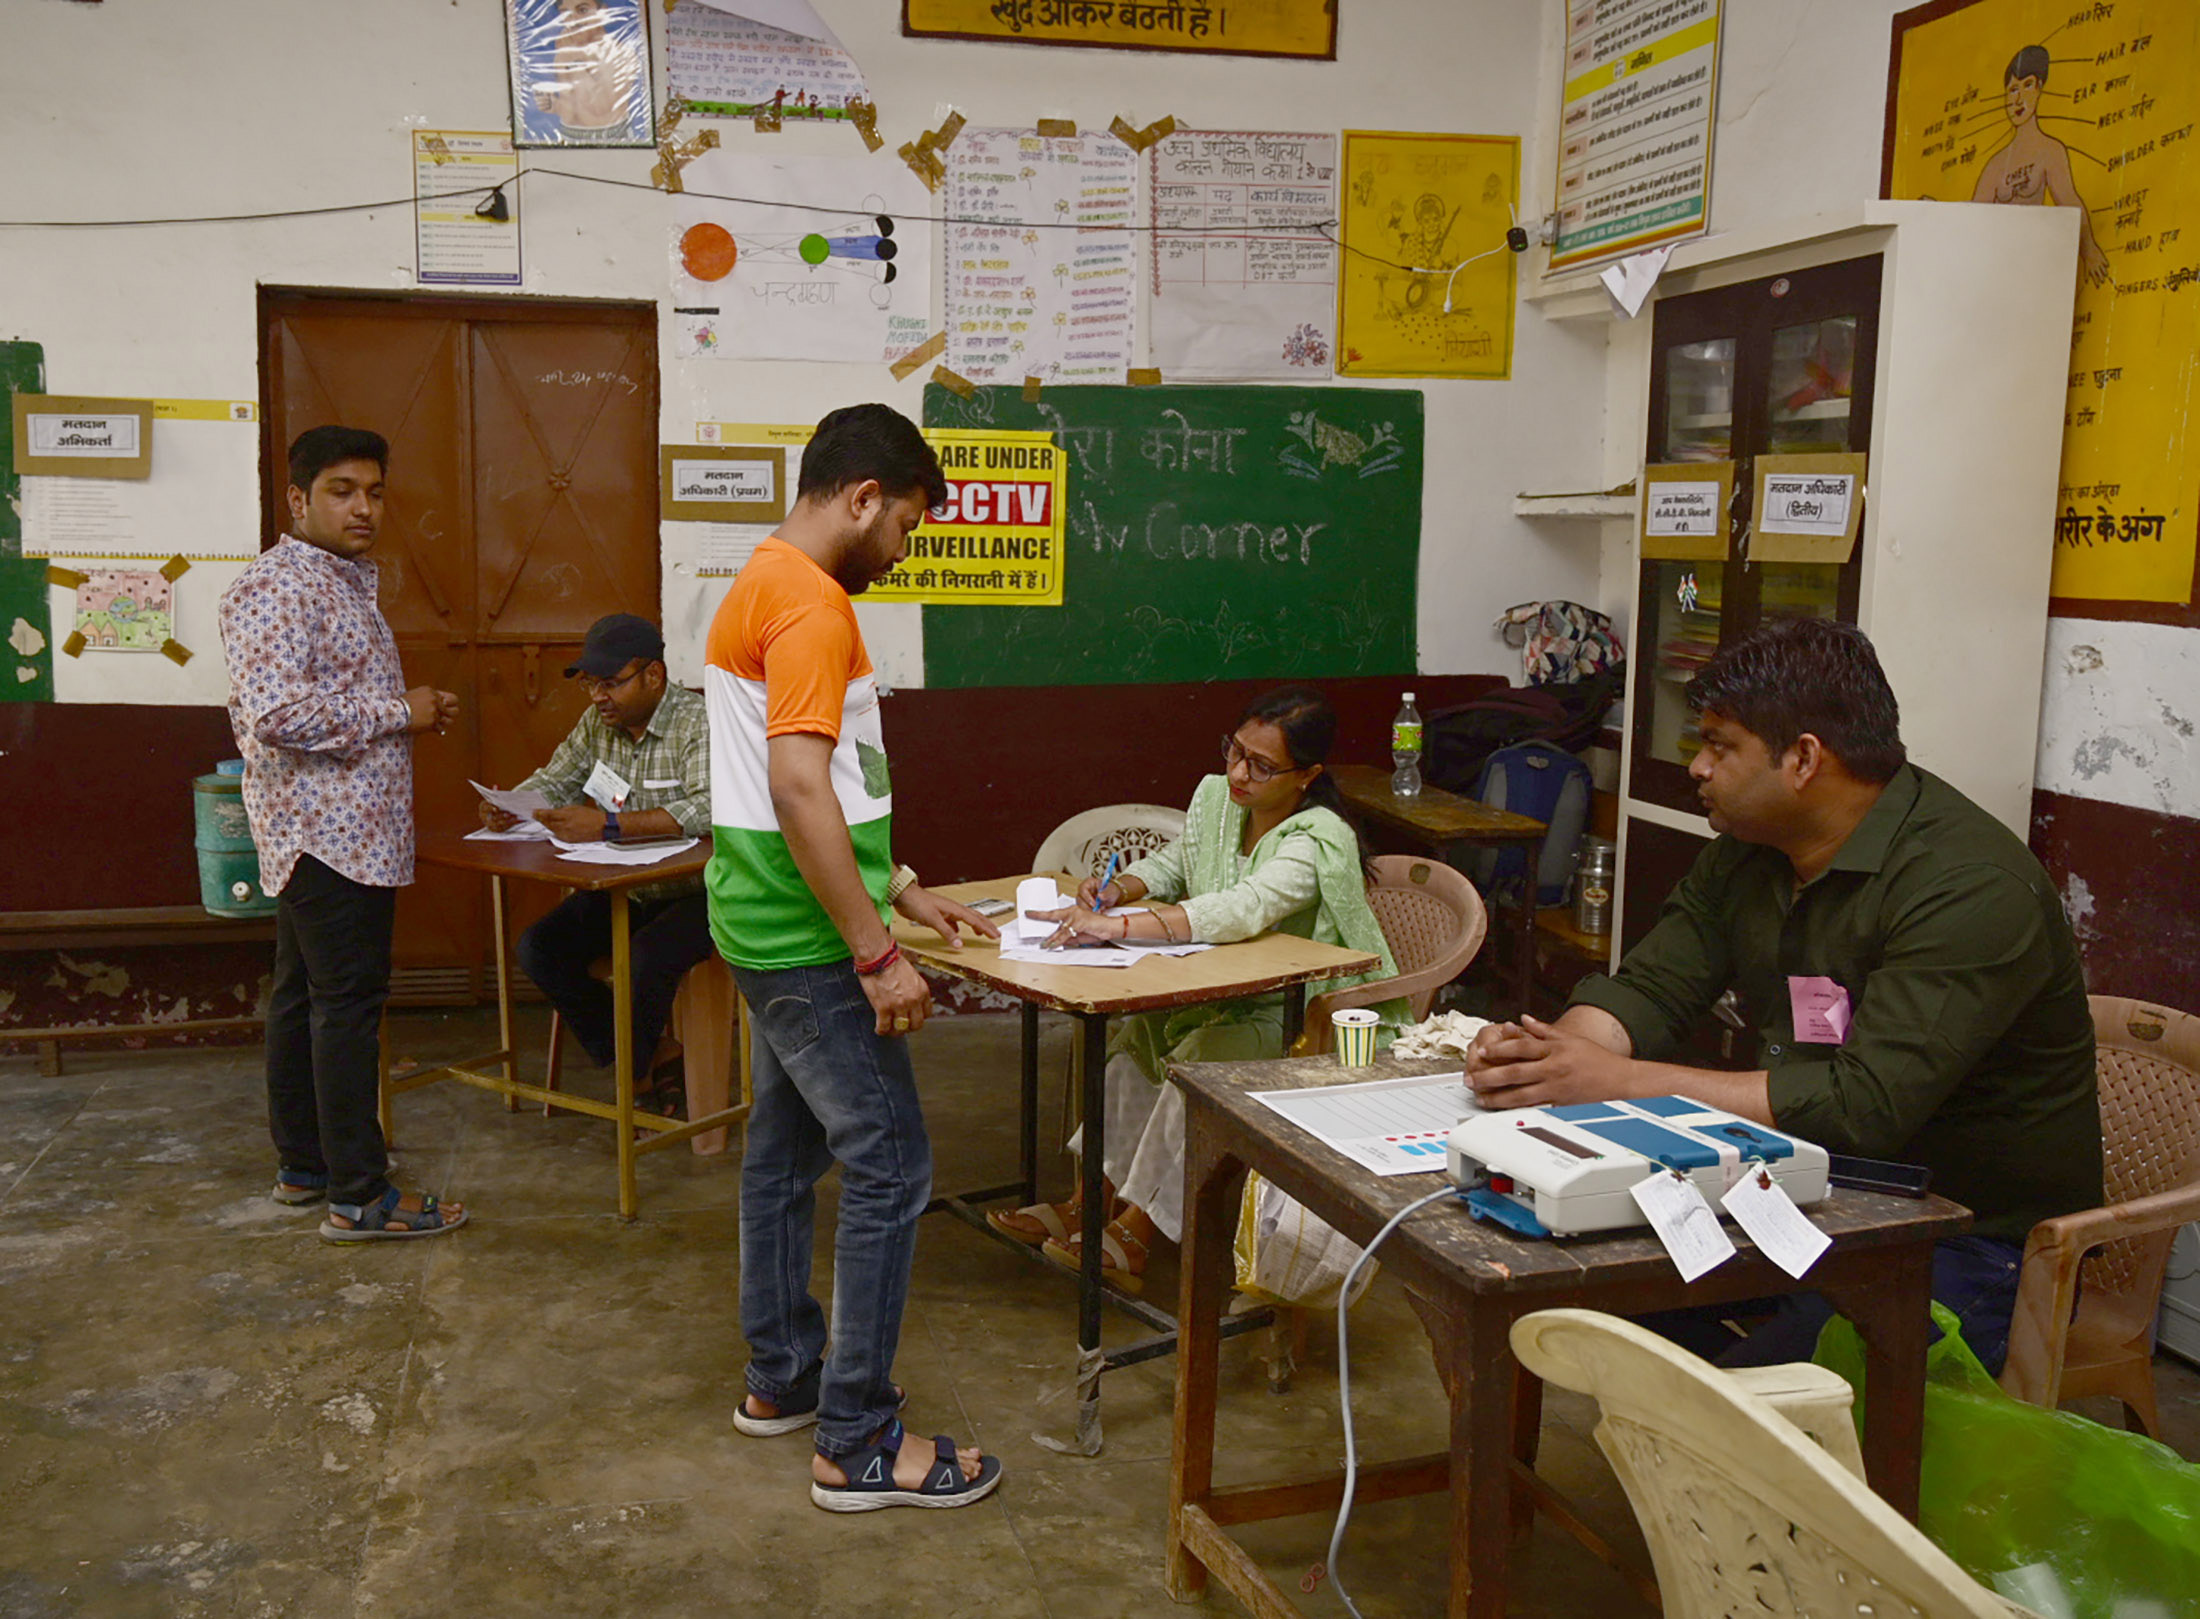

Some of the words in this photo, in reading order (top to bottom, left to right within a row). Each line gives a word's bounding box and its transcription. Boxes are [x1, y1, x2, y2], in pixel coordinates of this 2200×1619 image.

[1037, 0, 1115, 27] आकर
[2066, 10, 2091, 29] HEAD
[2095, 42, 2126, 66] HAIR
[2073, 83, 2097, 104] EAR
[2097, 108, 2126, 129] NECK
[2113, 188, 2149, 211] WRIST
[2124, 235, 2152, 254] HAND
[2114, 278, 2159, 298] FINGERS
[2068, 371, 2086, 388] NEE
[62, 419, 107, 430] मतदान
[940, 446, 979, 468] ARE
[985, 446, 1053, 471] UNDER
[704, 471, 744, 481] मतदान
[679, 485, 727, 497] अधिकारी
[1770, 482, 1803, 494] मतदान
[1805, 479, 1848, 495] अधिकारी
[930, 482, 1048, 523] CCTV
[1145, 501, 1328, 566] Corner
[2097, 505, 2116, 543] के
[2116, 506, 2167, 543] अंग
[905, 536, 1051, 560] URVEILLANCE
[915, 568, 937, 588] की
[941, 568, 1005, 589] निगरानी
[1008, 570, 1023, 590] में
